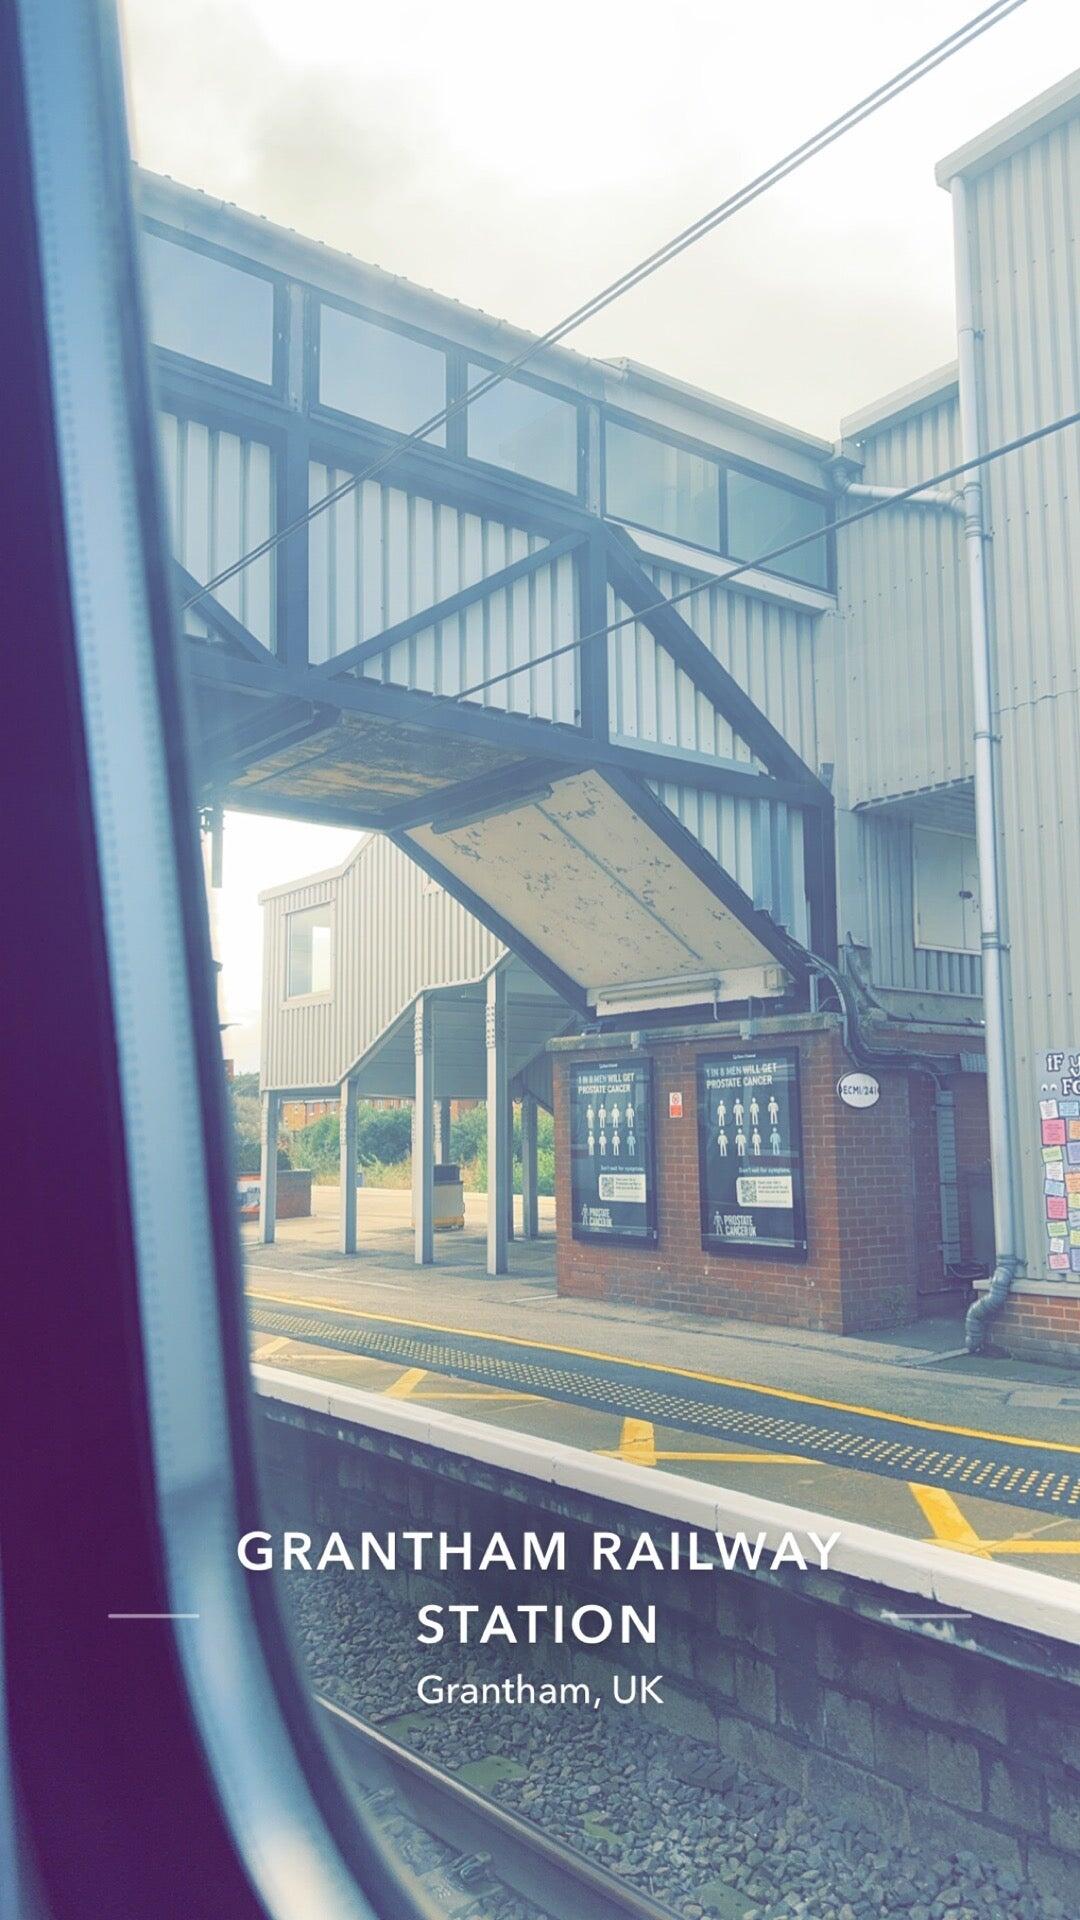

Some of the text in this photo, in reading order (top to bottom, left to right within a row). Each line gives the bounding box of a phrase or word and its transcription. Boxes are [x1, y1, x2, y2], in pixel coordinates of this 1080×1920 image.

[726, 1065, 742, 1076] MEN
[742, 1063, 761, 1074] WILL
[761, 1062, 777, 1073] GET
[607, 1073, 622, 1083] WILL
[622, 1072, 635, 1082] GET
[706, 1074, 773, 1089] PROSTATE CANCER
[577, 1083, 631, 1095] PROSTATE CANCER
[723, 1214, 753, 1226] PROSTATE
[725, 1224, 748, 1237] CANCER
